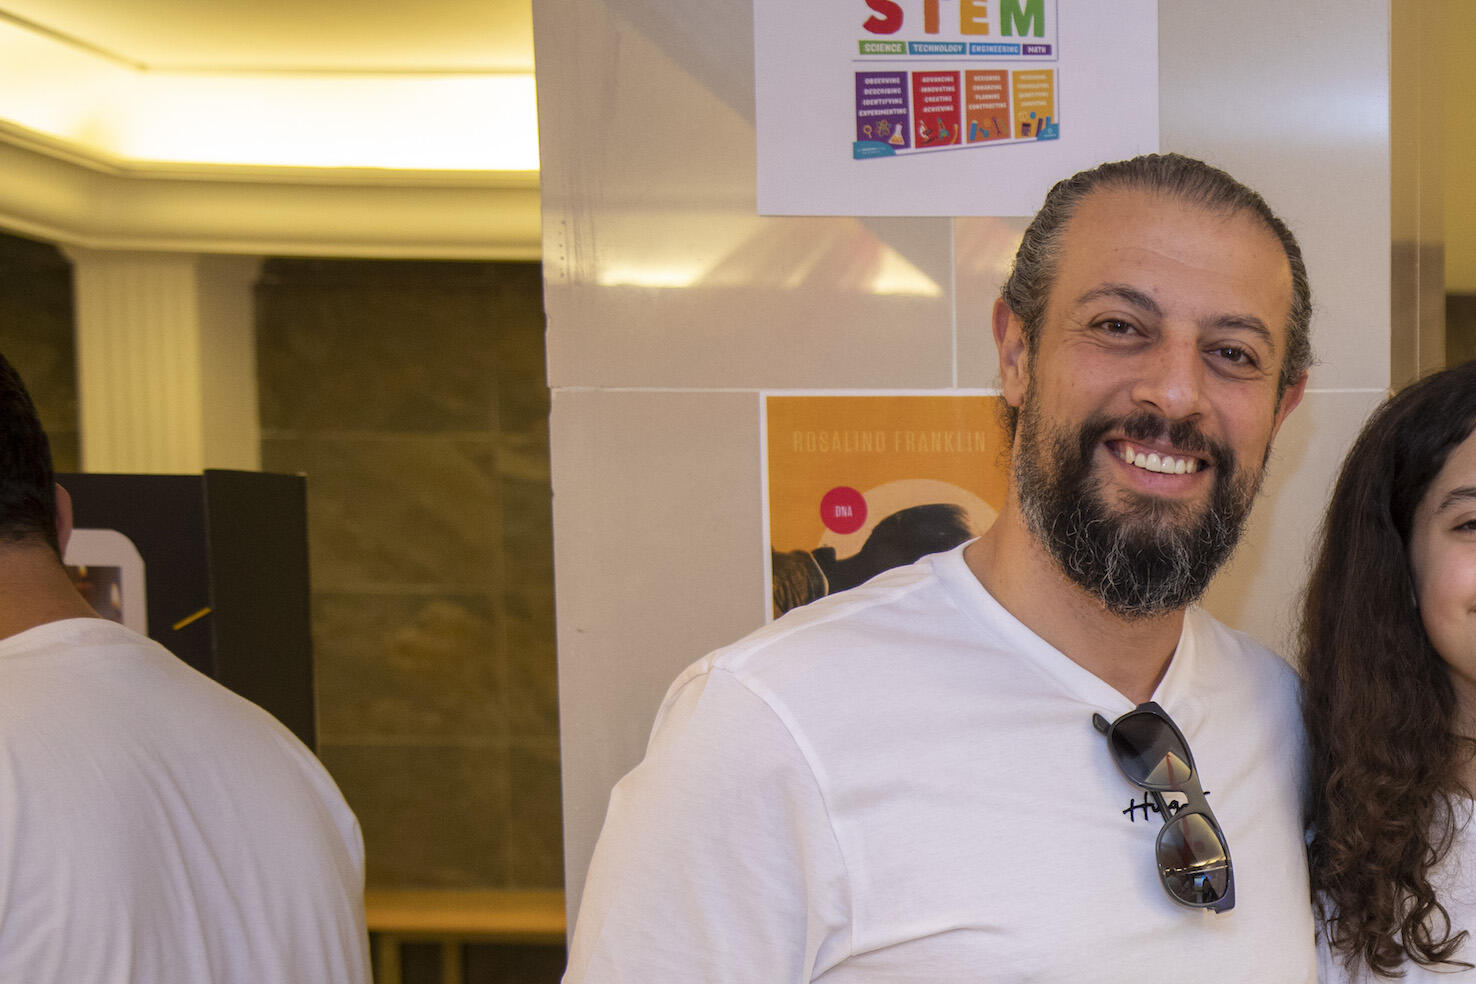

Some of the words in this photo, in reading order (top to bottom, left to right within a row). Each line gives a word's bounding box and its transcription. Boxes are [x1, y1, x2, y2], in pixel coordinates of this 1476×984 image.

[864, 43, 903, 53] SCIENCE
[913, 43, 963, 54] TECHNOLOGY
[971, 44, 1019, 54] ENGINEERING
[1027, 45, 1047, 55] MATH
[858, 107, 908, 117] EXPERIMENTING
[792, 430, 887, 453] ROSALIND
[895, 430, 987, 453] FRANKLIN
[834, 505, 854, 518] DNA
